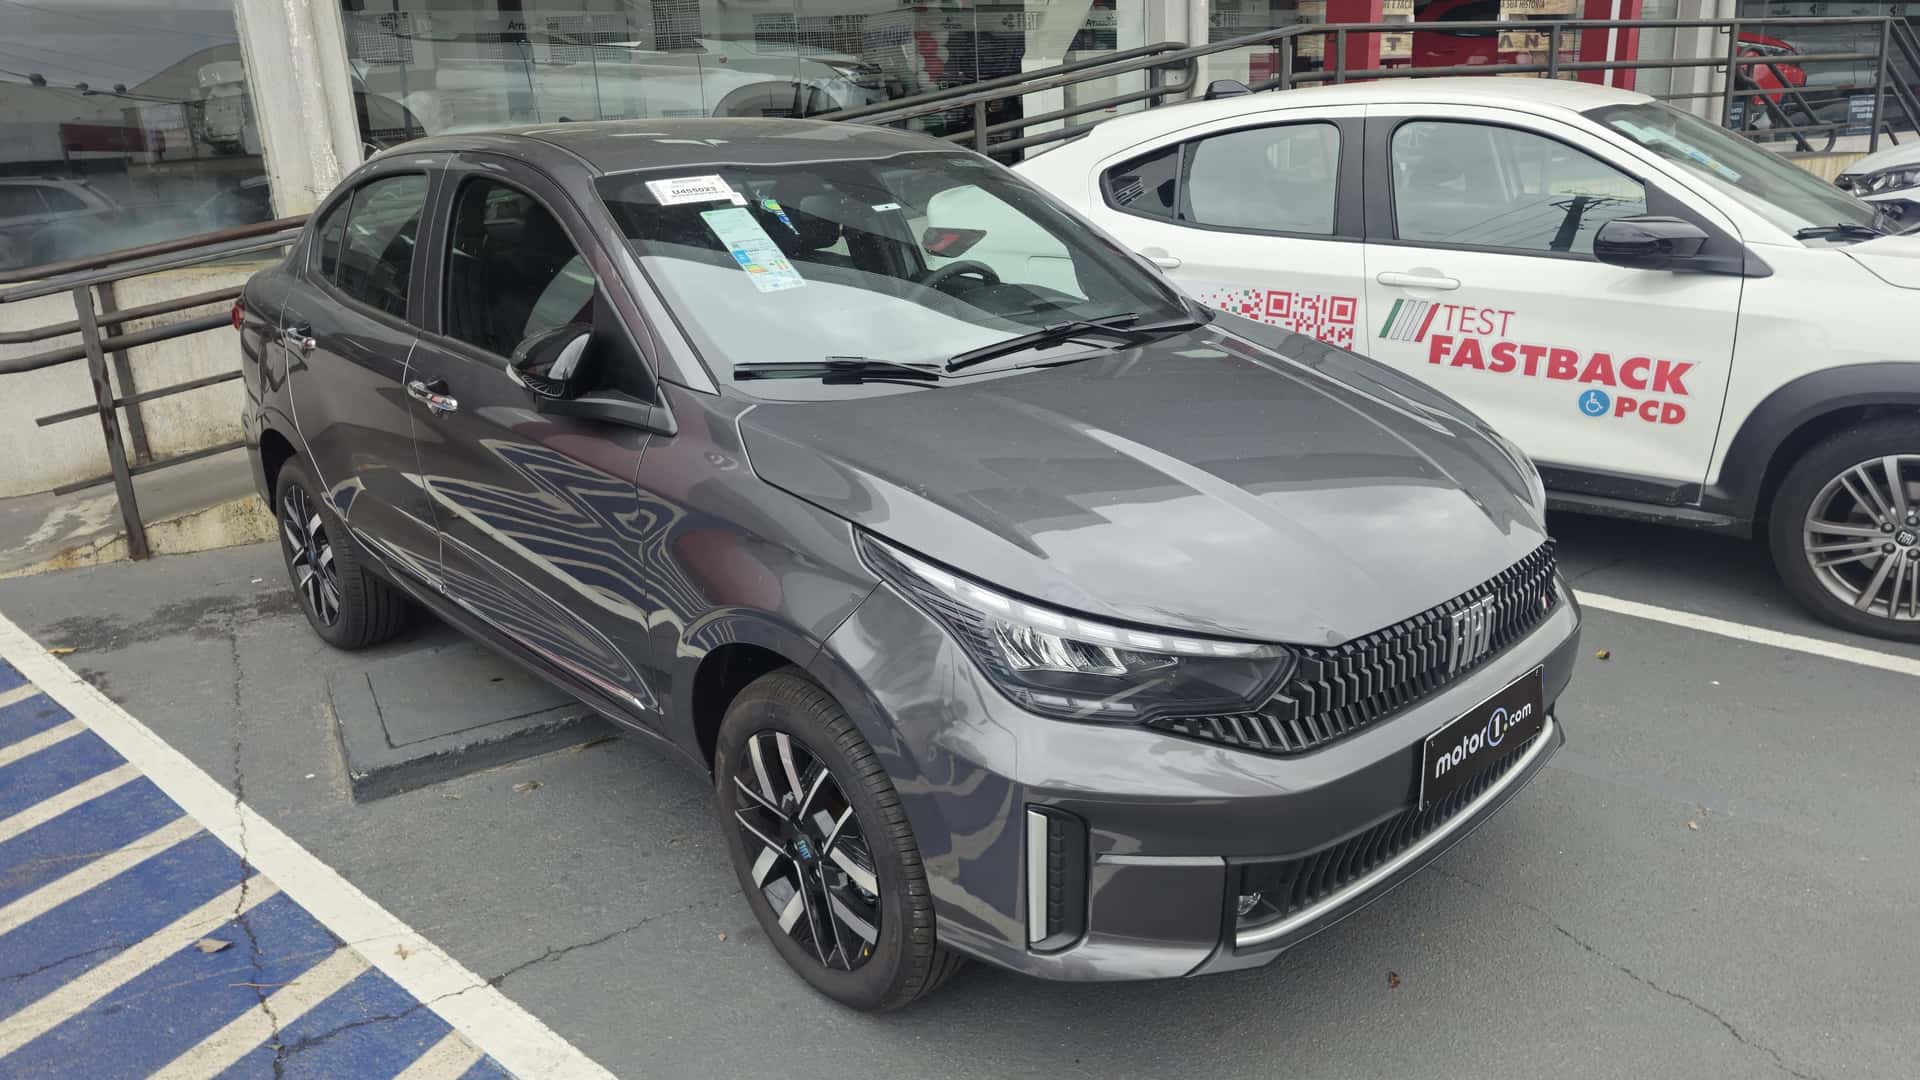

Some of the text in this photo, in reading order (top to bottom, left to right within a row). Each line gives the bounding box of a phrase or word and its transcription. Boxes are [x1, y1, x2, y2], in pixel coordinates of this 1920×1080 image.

[1443, 304, 1516, 337] TEST
[1428, 334, 1695, 396] FASTBACK
[1614, 396, 1687, 425] PCD
[1448, 593, 1495, 673] FIAT
[1435, 702, 1532, 779] motor1.com
